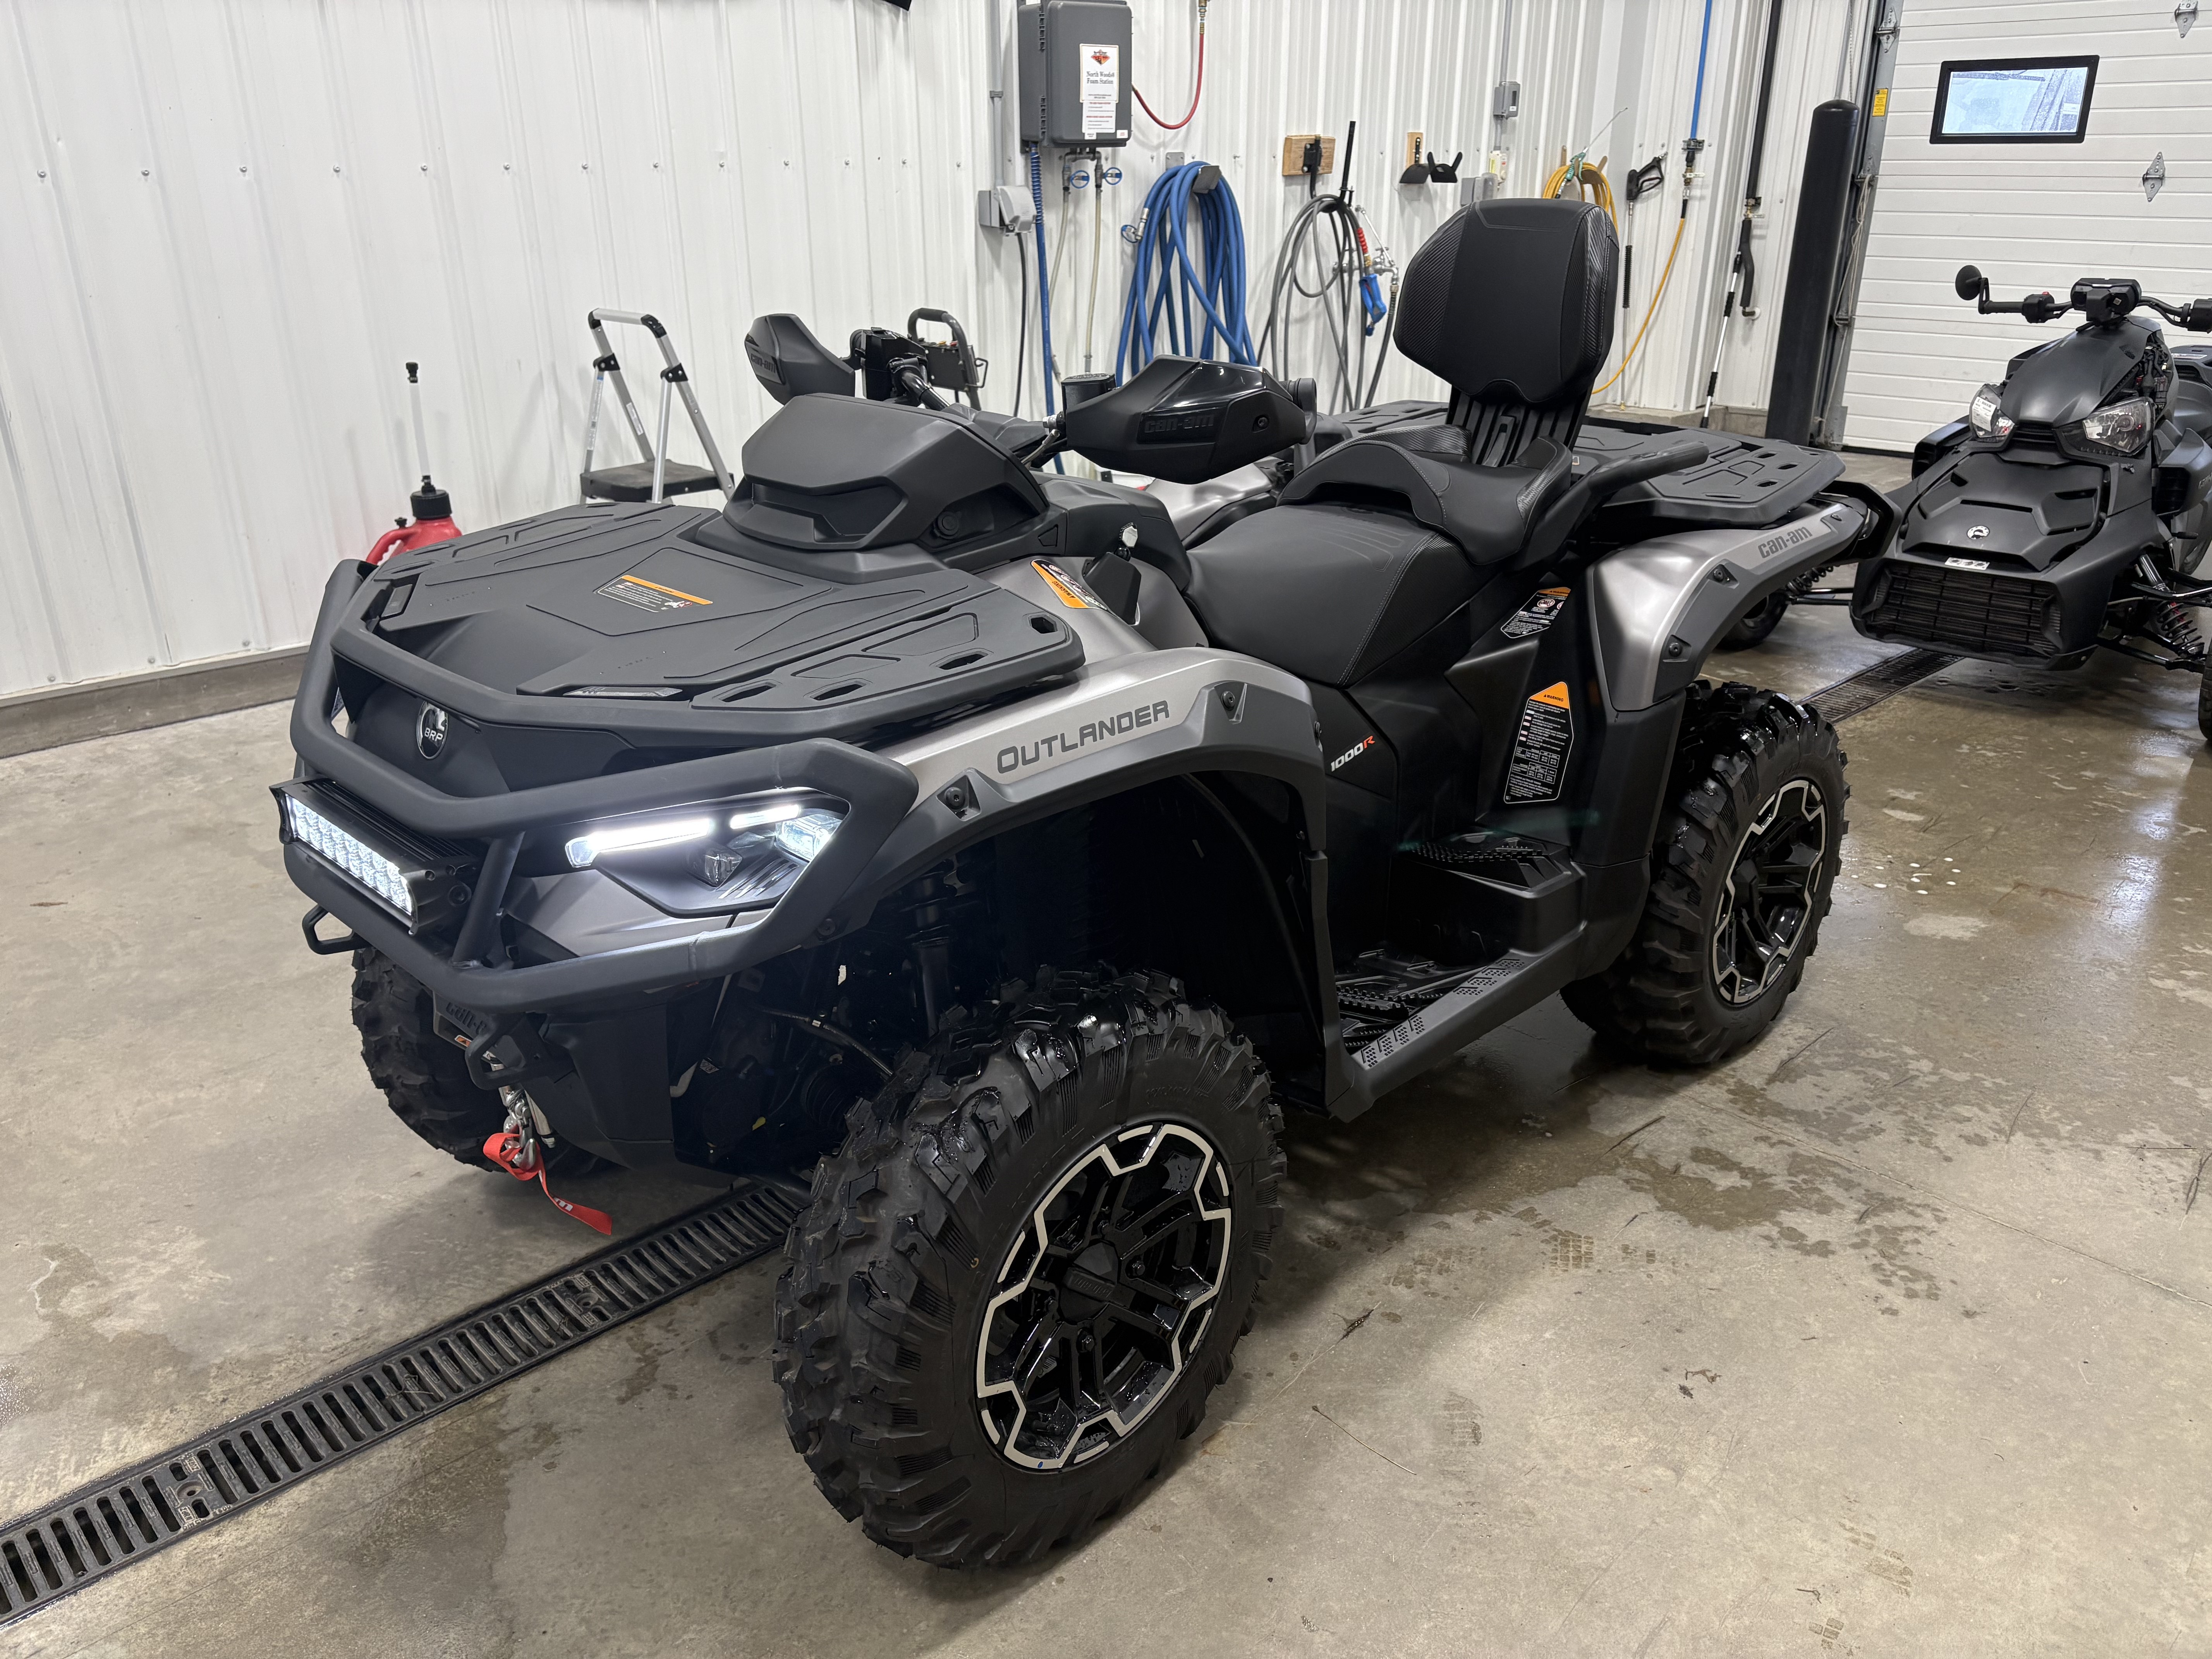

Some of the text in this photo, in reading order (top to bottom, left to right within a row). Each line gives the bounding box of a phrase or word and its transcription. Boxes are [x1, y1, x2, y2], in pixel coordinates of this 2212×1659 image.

[1144, 414, 1214, 433] can-am
[1758, 527, 1813, 558] can-am
[424, 727, 443, 742] BRP
[997, 700, 1170, 766] OUTLANDER
[1331, 736, 1375, 772] 1000R
